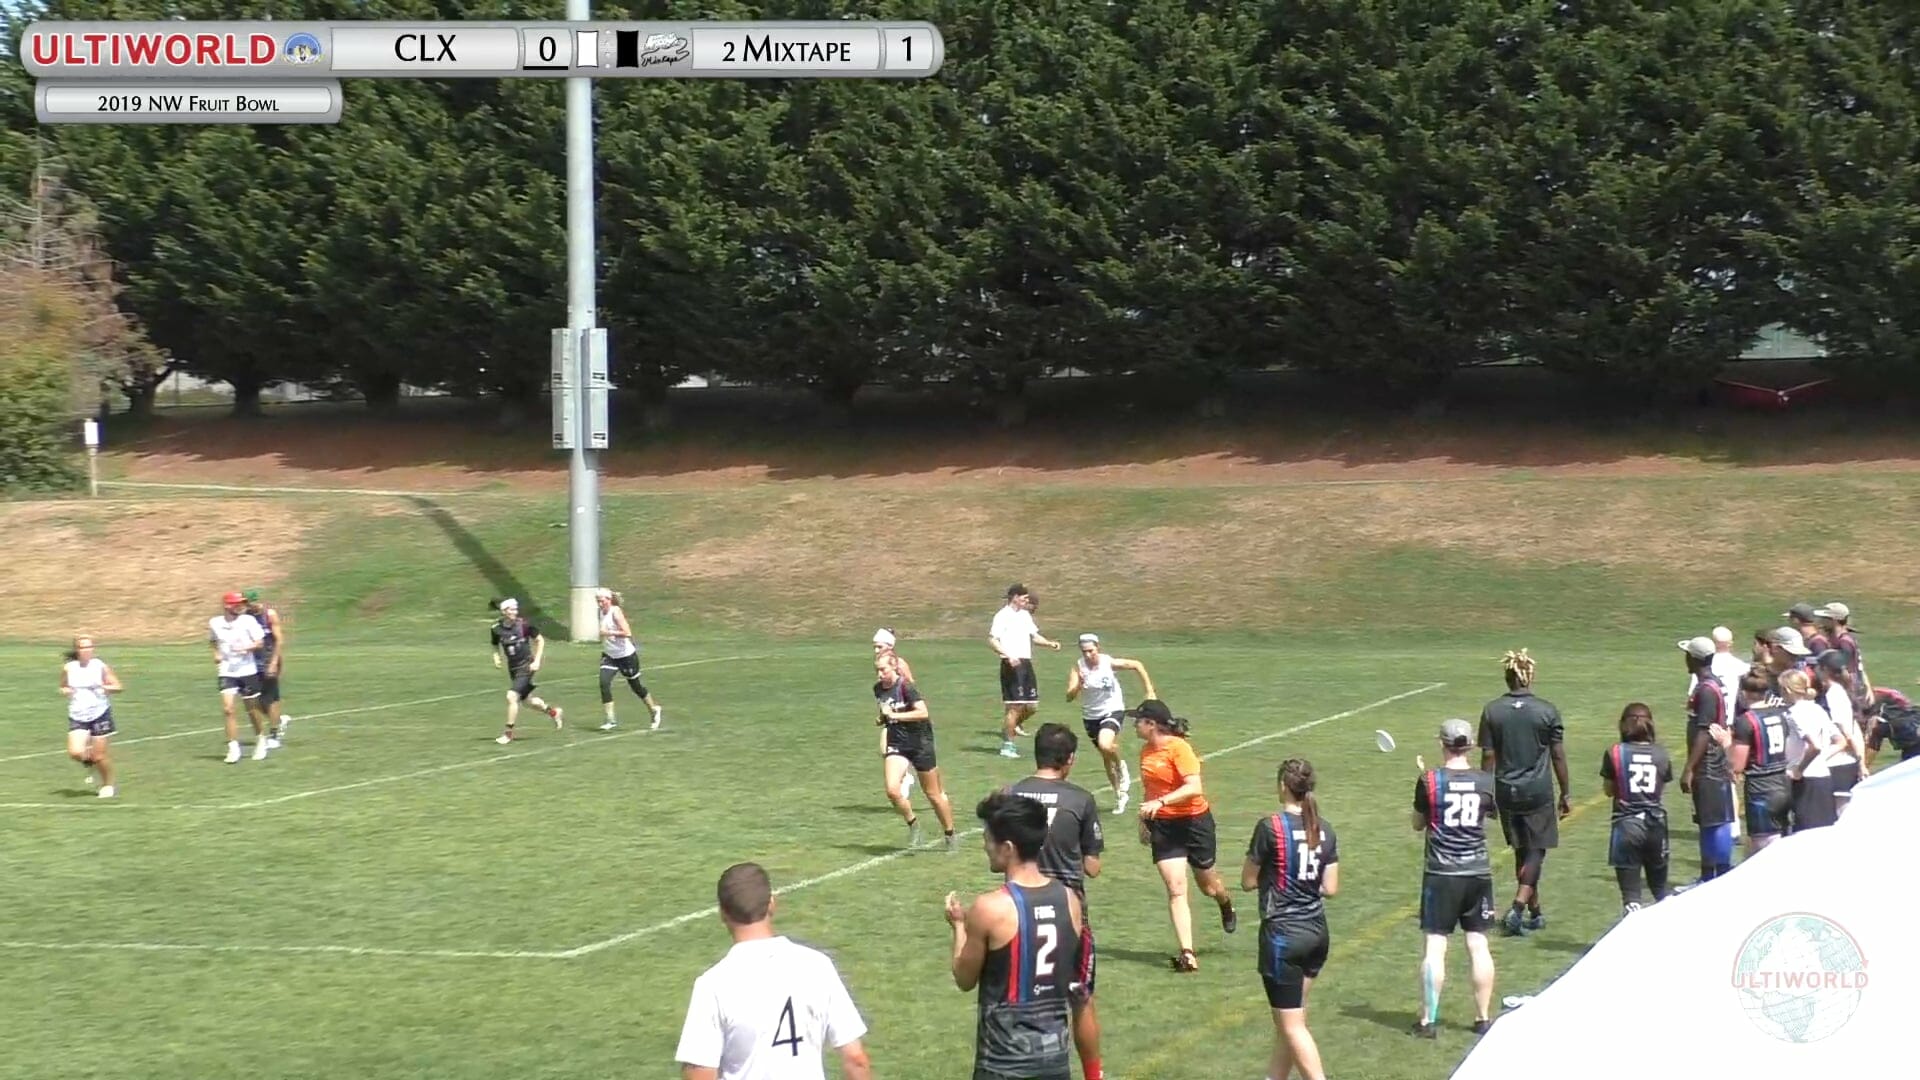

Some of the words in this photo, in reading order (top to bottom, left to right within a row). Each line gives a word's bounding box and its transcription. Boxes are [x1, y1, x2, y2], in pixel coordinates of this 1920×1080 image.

[1628, 764, 1657, 793] 23
[1443, 793, 1481, 827] 28
[1035, 923, 1058, 977] 2
[771, 995, 804, 1057] 4
